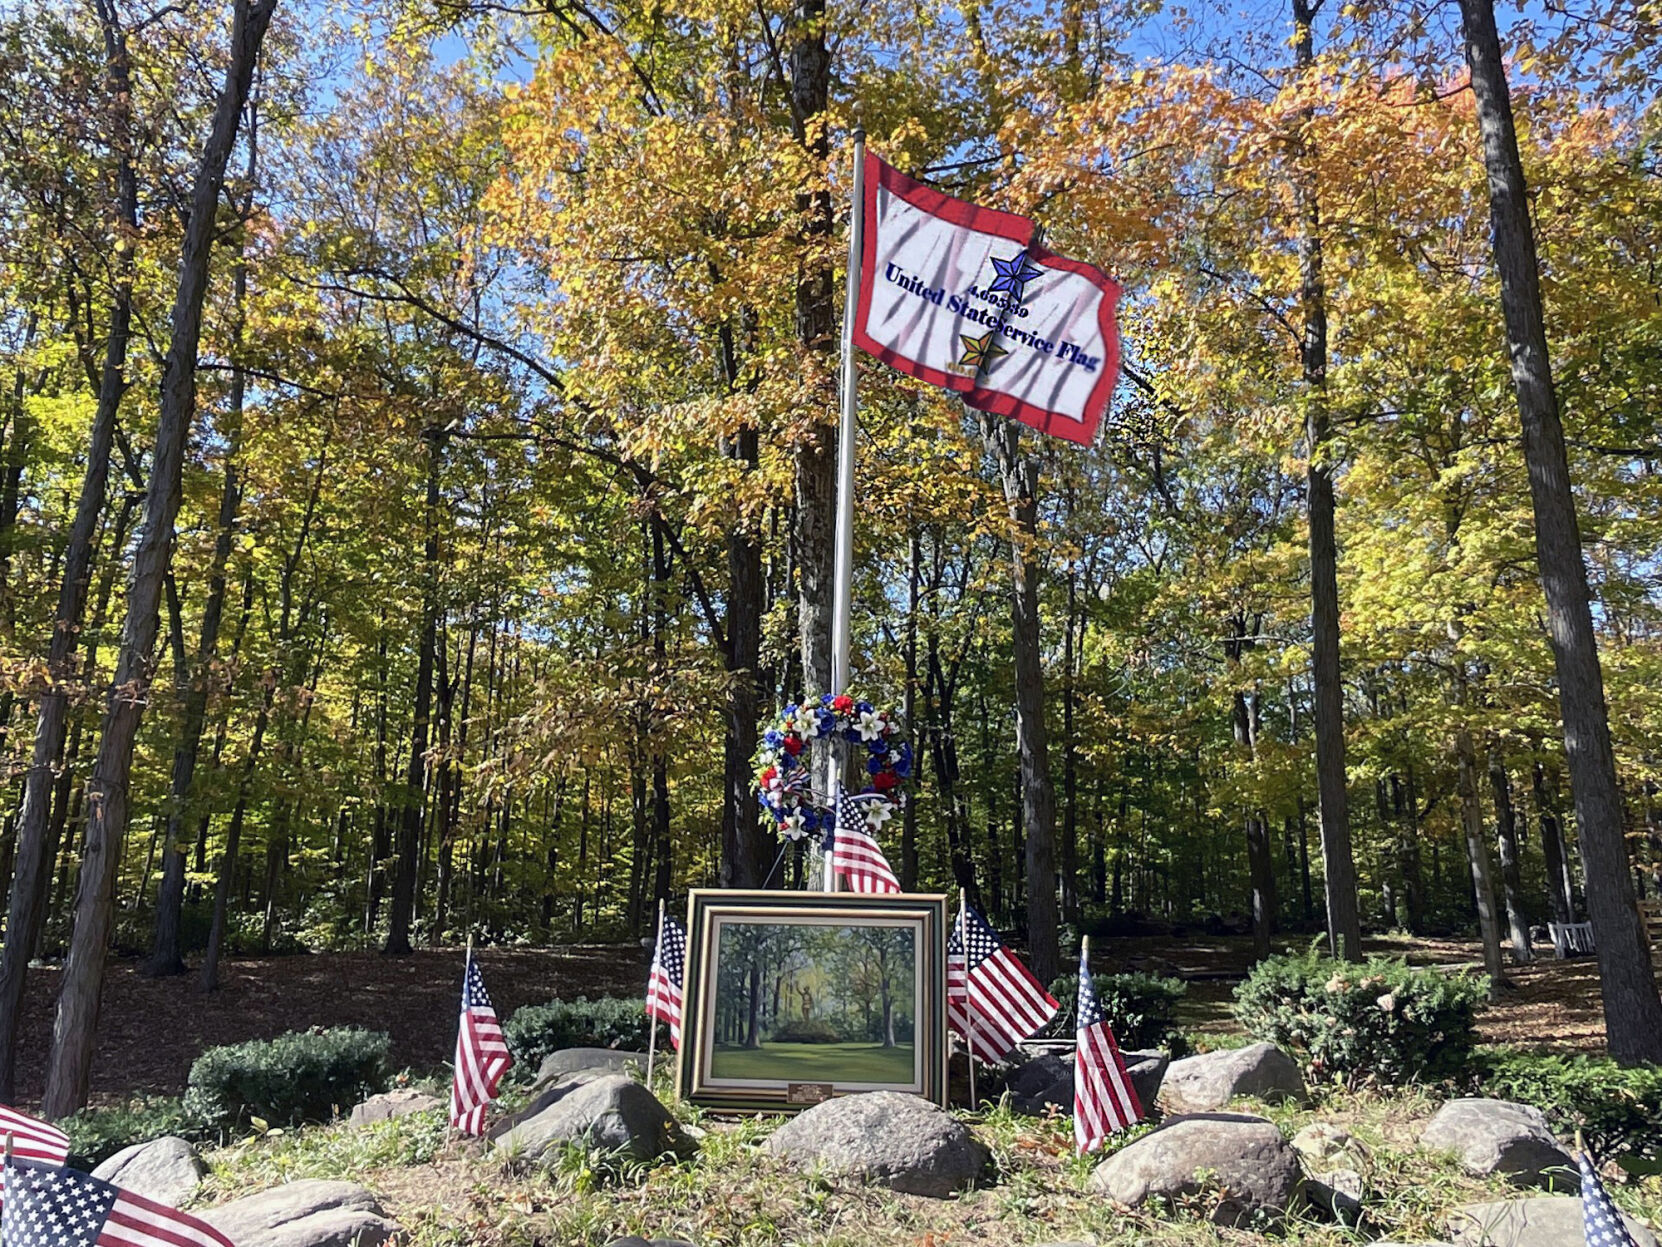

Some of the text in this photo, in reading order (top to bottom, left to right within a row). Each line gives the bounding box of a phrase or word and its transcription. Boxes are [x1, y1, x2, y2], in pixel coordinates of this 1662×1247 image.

[885, 262, 946, 306] United
[946, 294, 998, 329] State
[1055, 340, 1100, 373] Flag
